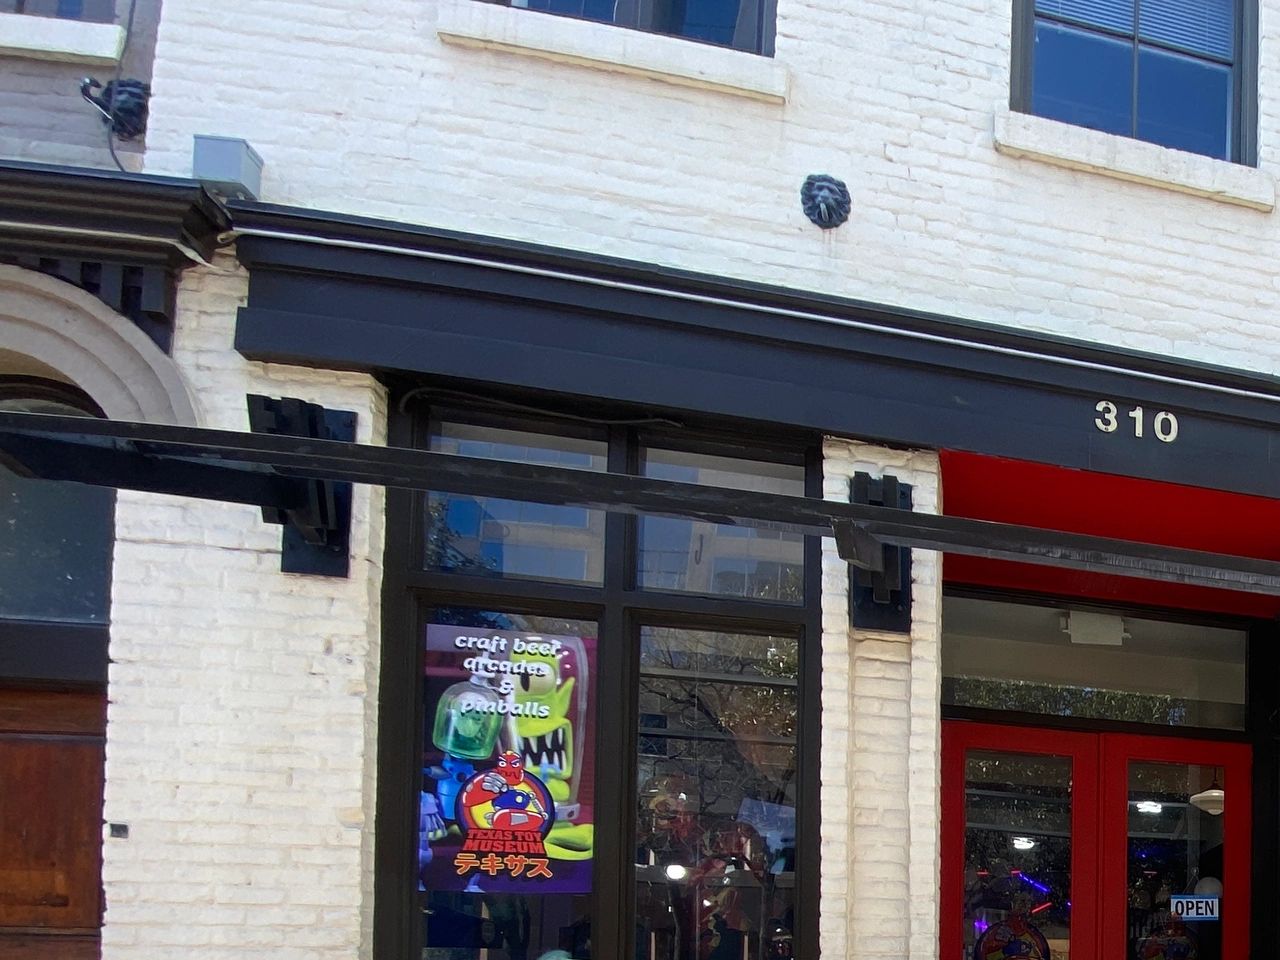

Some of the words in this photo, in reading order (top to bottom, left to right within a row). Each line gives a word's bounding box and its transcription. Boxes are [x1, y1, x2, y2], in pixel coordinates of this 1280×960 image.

[1095, 400, 1179, 443] 310
[455, 635, 508, 654] craft
[463, 656, 550, 677] arcades
[501, 680, 514, 695] &
[461, 699, 550, 719] pinballs
[467, 829, 512, 841] TEXAS
[514, 831, 542, 842] TOY
[462, 839, 545, 854] MUSEUM
[454, 853, 553, 878] テキサス
[1174, 900, 1215, 917] OPEN
